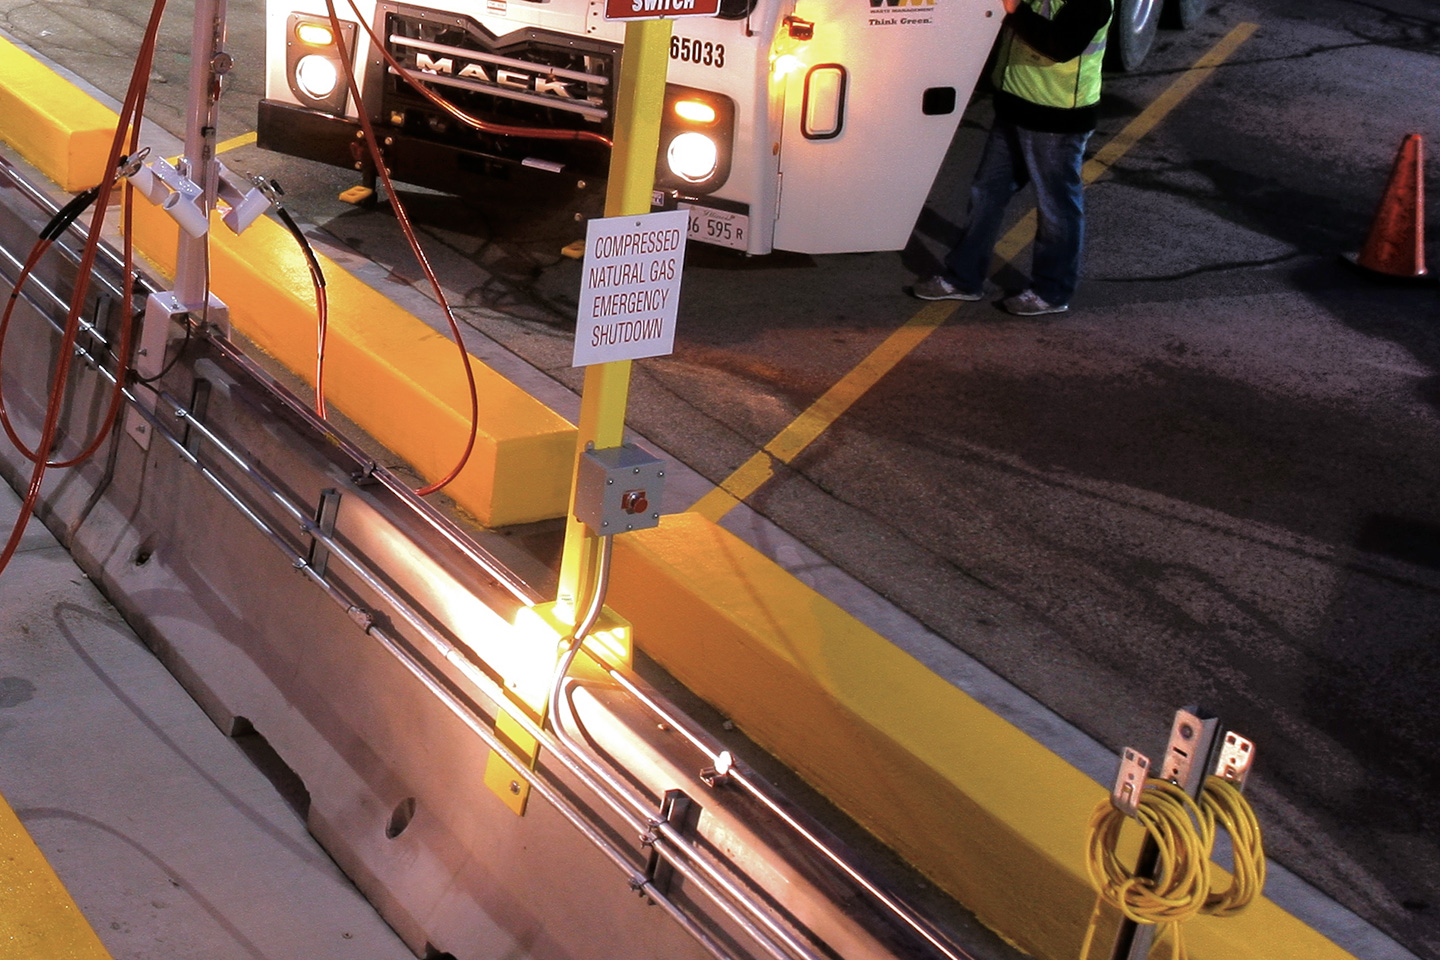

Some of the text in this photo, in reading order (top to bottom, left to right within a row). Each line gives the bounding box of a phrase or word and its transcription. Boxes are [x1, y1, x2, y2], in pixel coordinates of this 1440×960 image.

[868, 18, 898, 26] Think
[669, 35, 725, 69] 65033
[416, 52, 574, 99] MACK
[594, 228, 680, 260] COMPRESSED
[707, 219, 733, 240] 595
[735, 227, 744, 241] R
[588, 258, 676, 290] NATURAL GAS
[592, 288, 670, 319] EMERGENCY
[591, 317, 664, 348] SHUTDOWN
